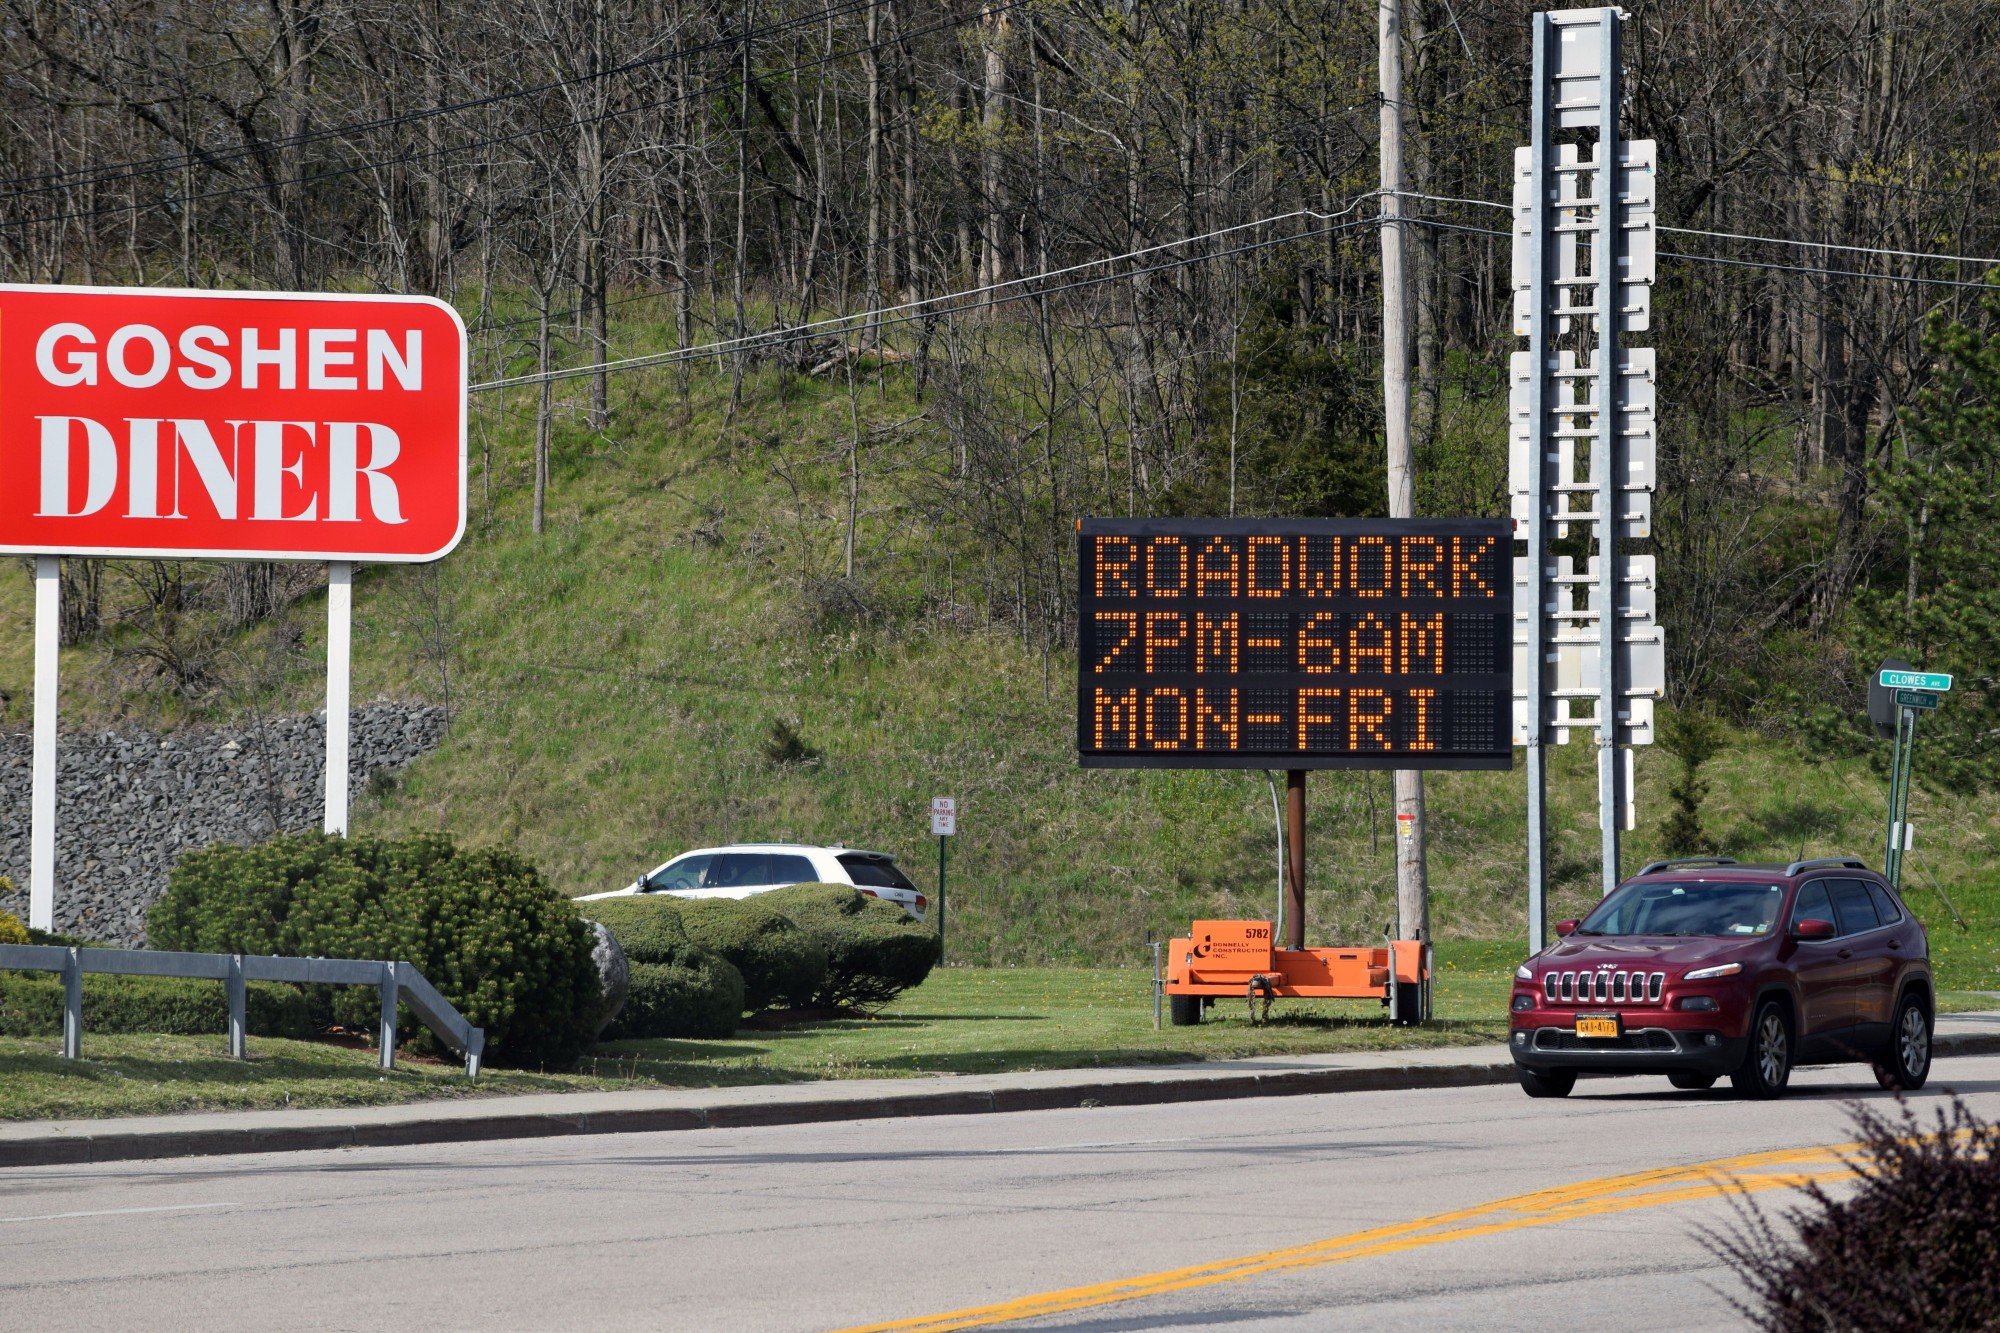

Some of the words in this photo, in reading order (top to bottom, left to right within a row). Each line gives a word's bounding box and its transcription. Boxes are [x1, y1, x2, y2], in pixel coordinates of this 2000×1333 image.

[35, 322, 423, 391] GOSHEN
[33, 415, 409, 525] DINER
[1096, 536, 1495, 598] ROADWORK
[1095, 612, 1443, 674] 7PM-6AM
[1889, 674, 1926, 686] CLOWES
[1900, 693, 1927, 705] GREENWICH
[1095, 688, 1434, 750] MON-FRI
[939, 800, 949, 808] NO
[1245, 928, 1269, 939] 5782
